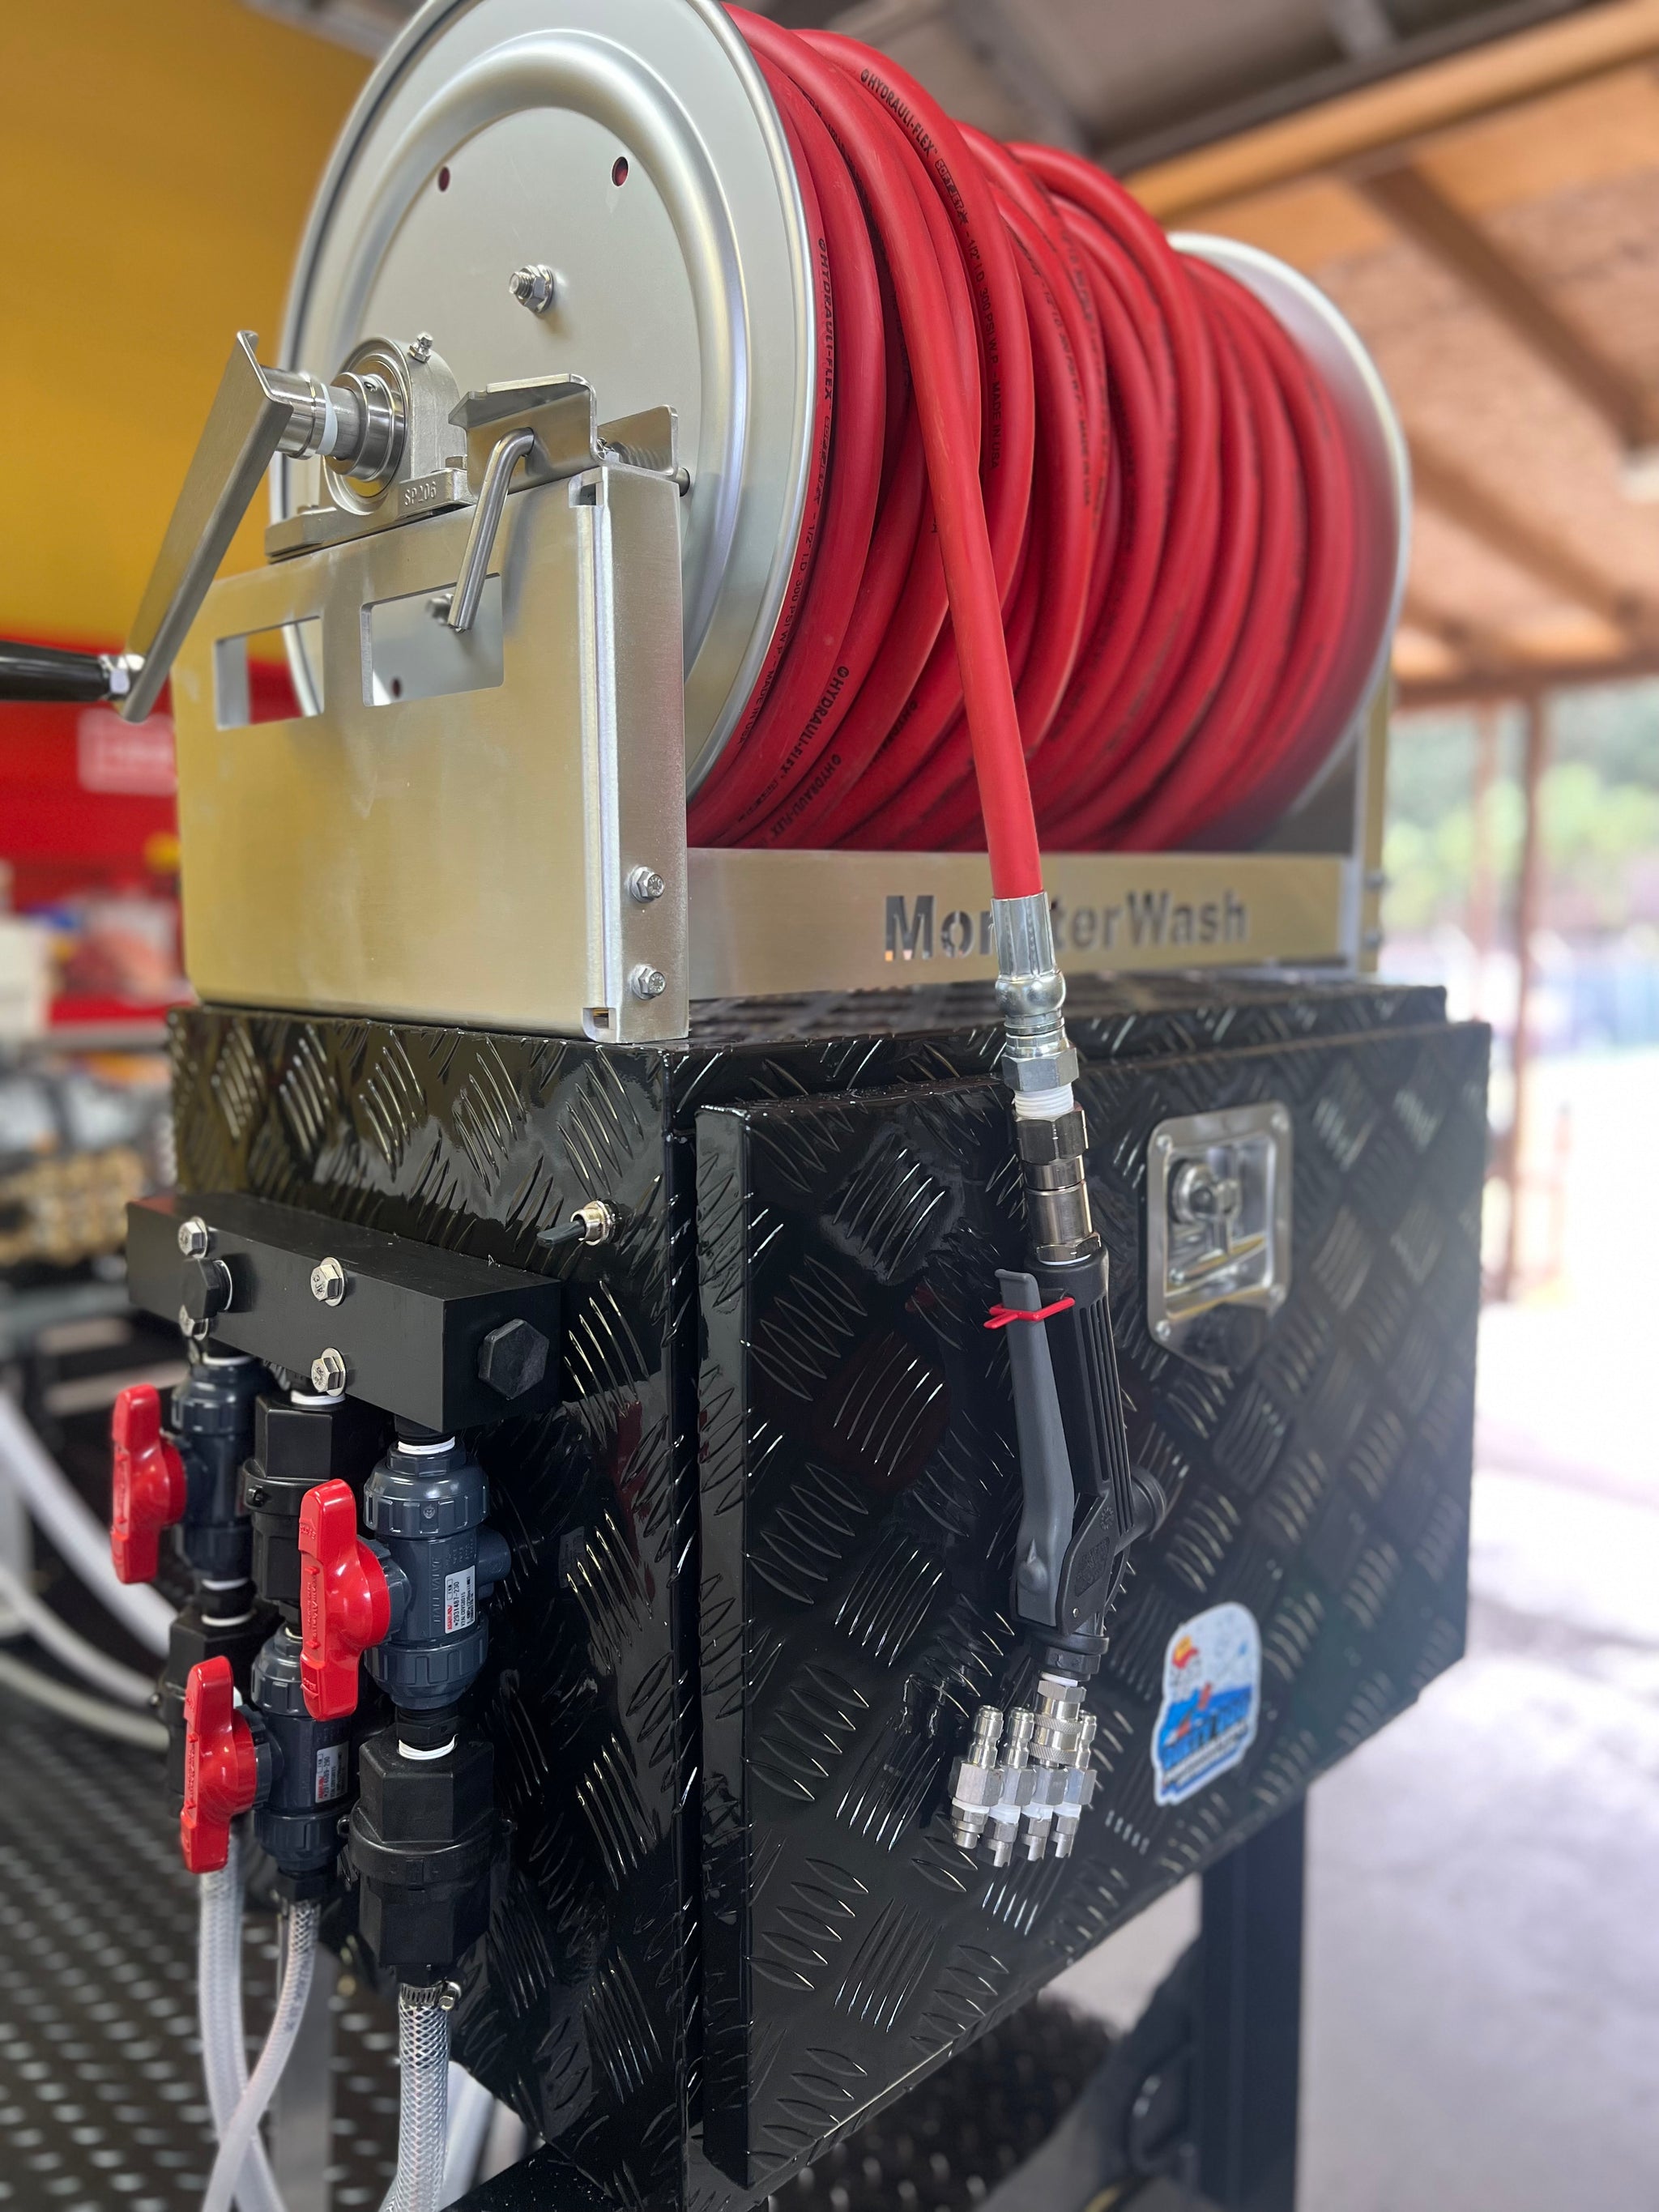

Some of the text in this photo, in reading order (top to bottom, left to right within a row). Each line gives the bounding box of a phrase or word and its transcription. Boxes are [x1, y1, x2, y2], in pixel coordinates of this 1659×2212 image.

[980, 288, 991, 311] 300
[985, 313, 995, 335] PSI
[992, 380, 1001, 420] MADE
[992, 424, 1001, 440] IN
[992, 441, 1000, 469] USA
